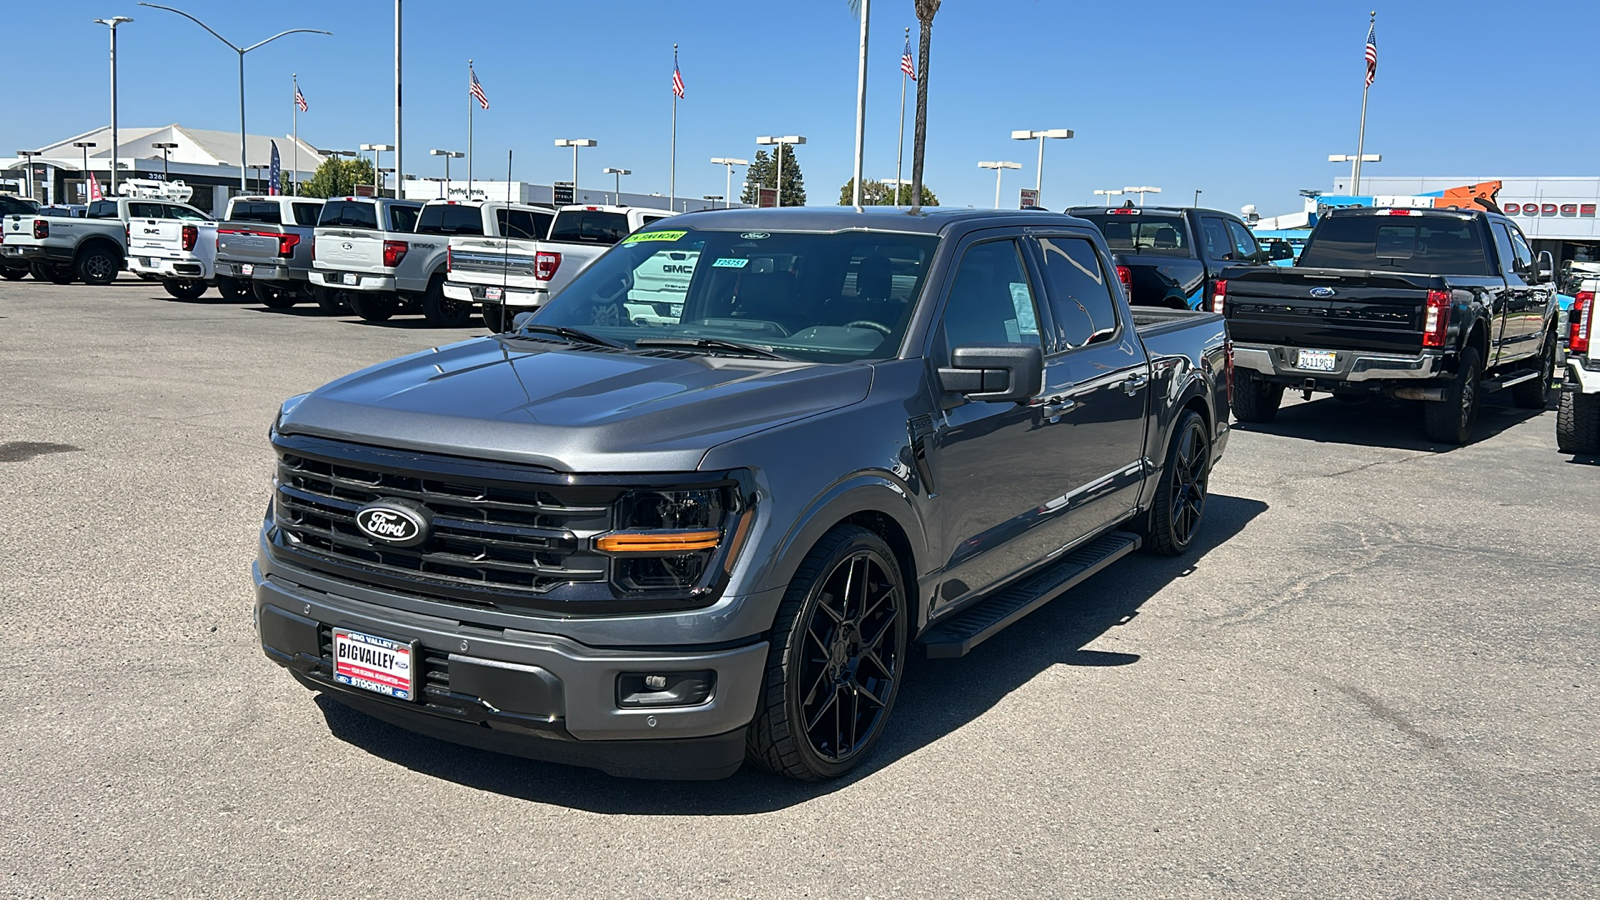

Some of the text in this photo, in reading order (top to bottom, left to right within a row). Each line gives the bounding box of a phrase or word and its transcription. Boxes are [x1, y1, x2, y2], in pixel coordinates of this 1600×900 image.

[1503, 203, 1597, 217] DODGE
[663, 265, 693, 274] GMC
[1300, 357, 1334, 368] 34119G3
[367, 511, 407, 537] Ford
[352, 632, 392, 649] BIG VALLEY
[338, 642, 395, 670] BIGVALLEY
[351, 677, 393, 695] STOCKTON
